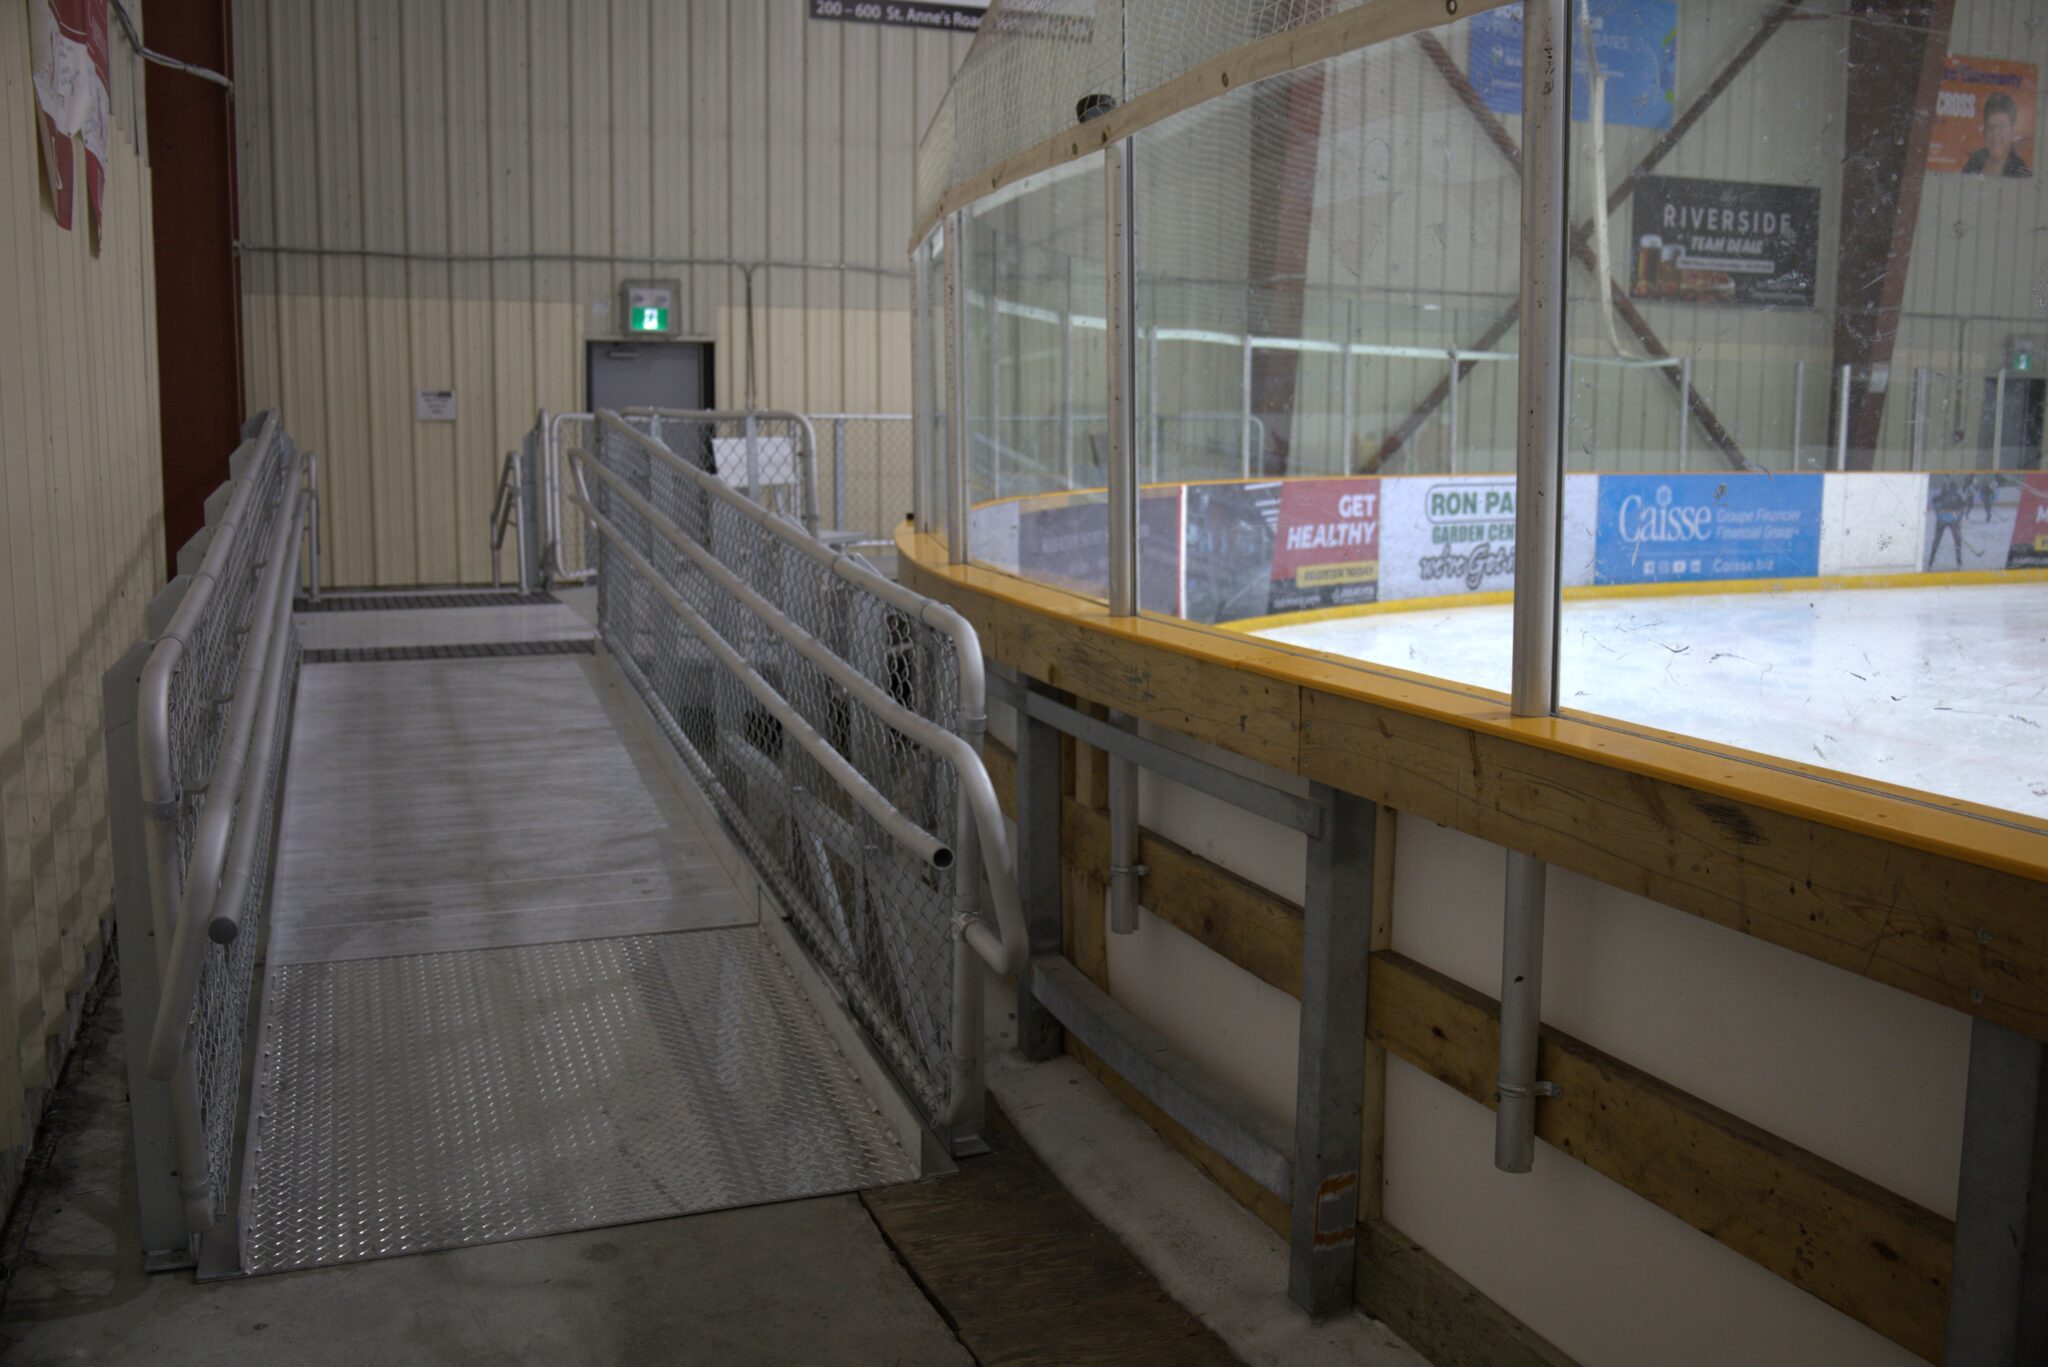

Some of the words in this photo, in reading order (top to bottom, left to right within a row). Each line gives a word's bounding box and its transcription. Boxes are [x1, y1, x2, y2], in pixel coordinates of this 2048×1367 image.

[816, 0, 842, 15] 200
[855, 4, 882, 19] 600
[886, 6, 903, 21] St.
[907, 9, 951, 27] Anne's
[1663, 202, 1792, 235] RIVERSIDE
[1690, 235, 1727, 252] TEAM
[1338, 493, 1376, 519] GET
[1431, 491, 1478, 516] RON
[1619, 485, 1712, 543] Caisse
[1286, 521, 1376, 551] HEALTHY
[1432, 525, 1485, 544] GARDEN
[1715, 524, 1762, 540] Financial
[1711, 557, 1776, 574] Caisse.biz
